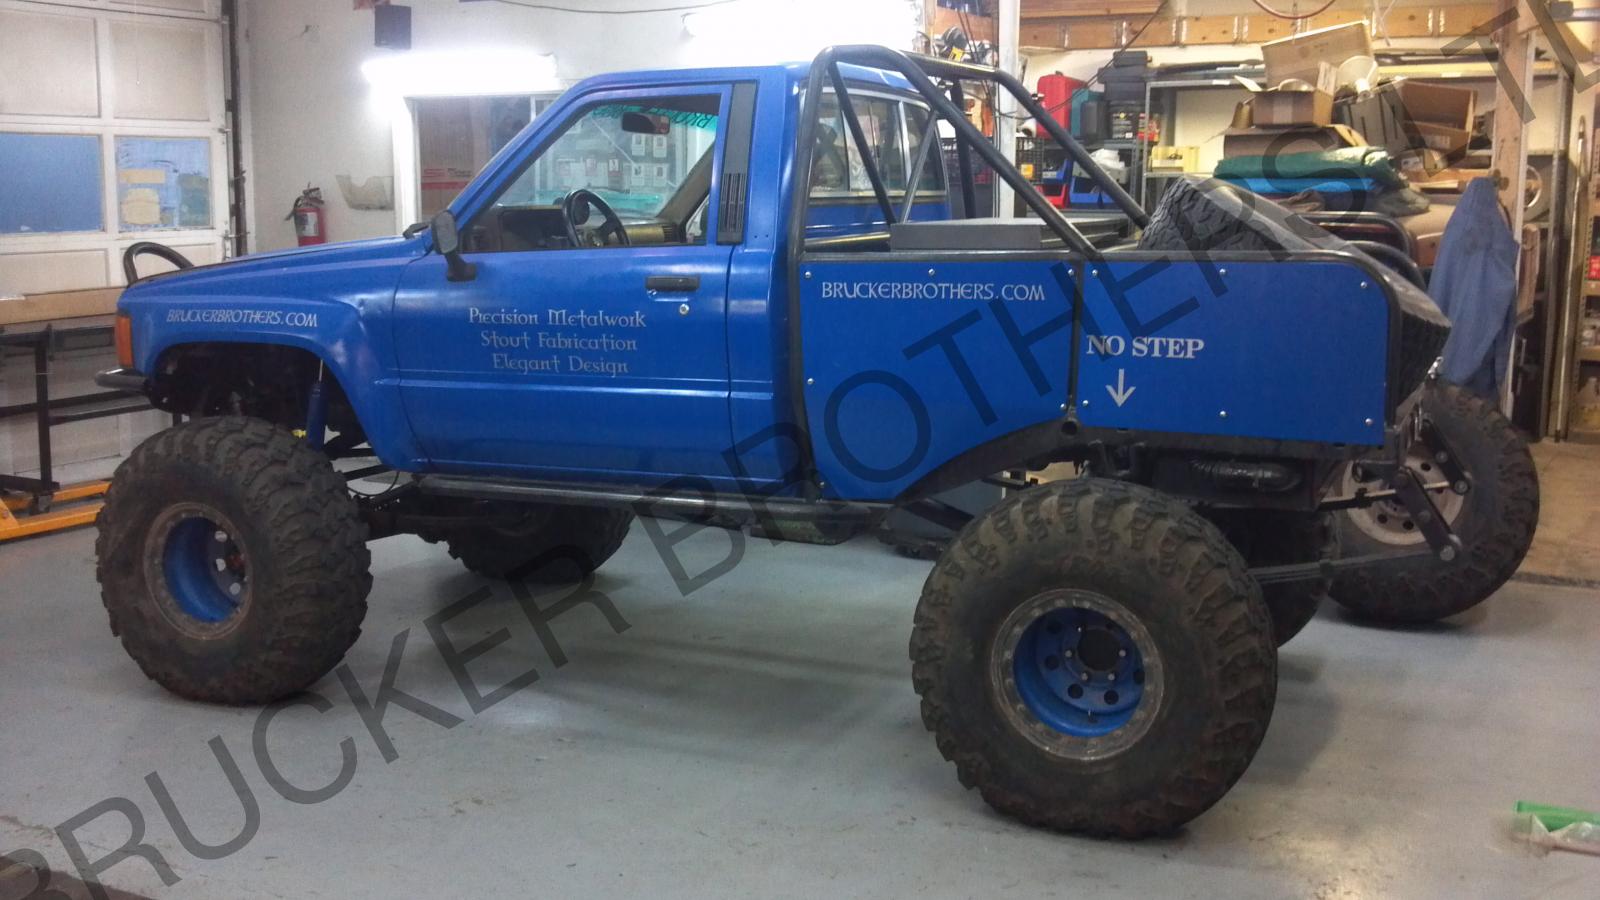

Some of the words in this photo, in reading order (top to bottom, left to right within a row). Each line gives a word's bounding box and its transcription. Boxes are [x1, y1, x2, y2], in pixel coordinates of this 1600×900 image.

[822, 281, 1045, 301] BRUCKERBROTHERS.COM
[166, 308, 318, 328] BRUCKERBROTHERS.COM
[468, 307, 539, 325] Precision
[548, 308, 647, 328] Metalwork
[480, 330, 531, 349] Stout
[538, 332, 638, 352] Fabrication
[1086, 335, 1125, 356] NO
[1132, 336, 1205, 359] STEP
[492, 353, 560, 375] Elegant
[568, 355, 629, 378] Design
